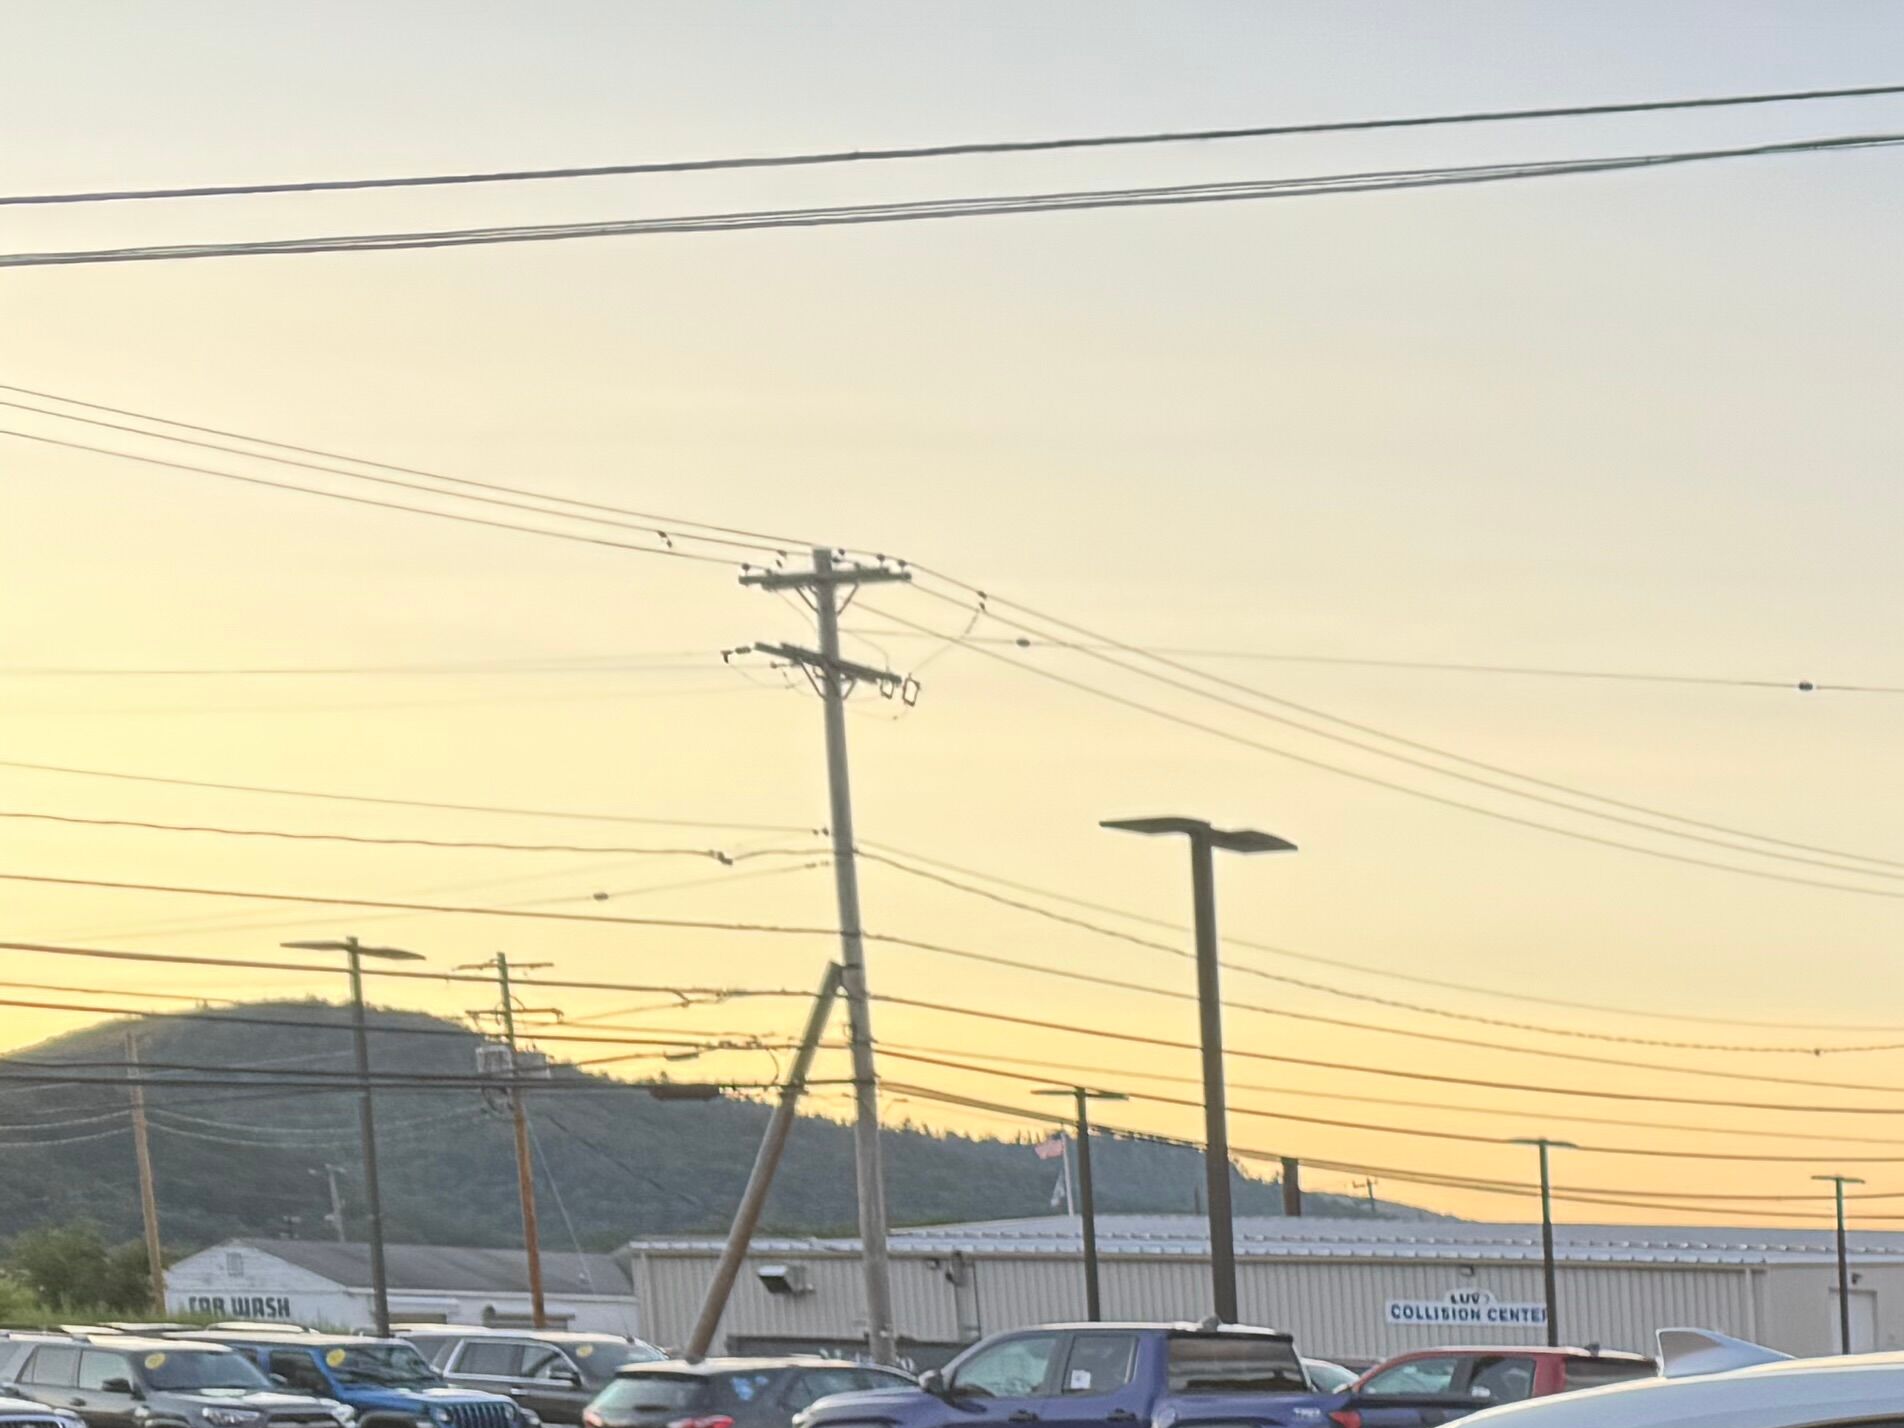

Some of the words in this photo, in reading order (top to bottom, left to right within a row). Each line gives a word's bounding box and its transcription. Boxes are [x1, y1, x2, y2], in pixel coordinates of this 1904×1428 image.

[188, 1295, 225, 1318] CAR
[231, 1295, 291, 1318] WASH
[1390, 1303, 1482, 1322] COLLISION
